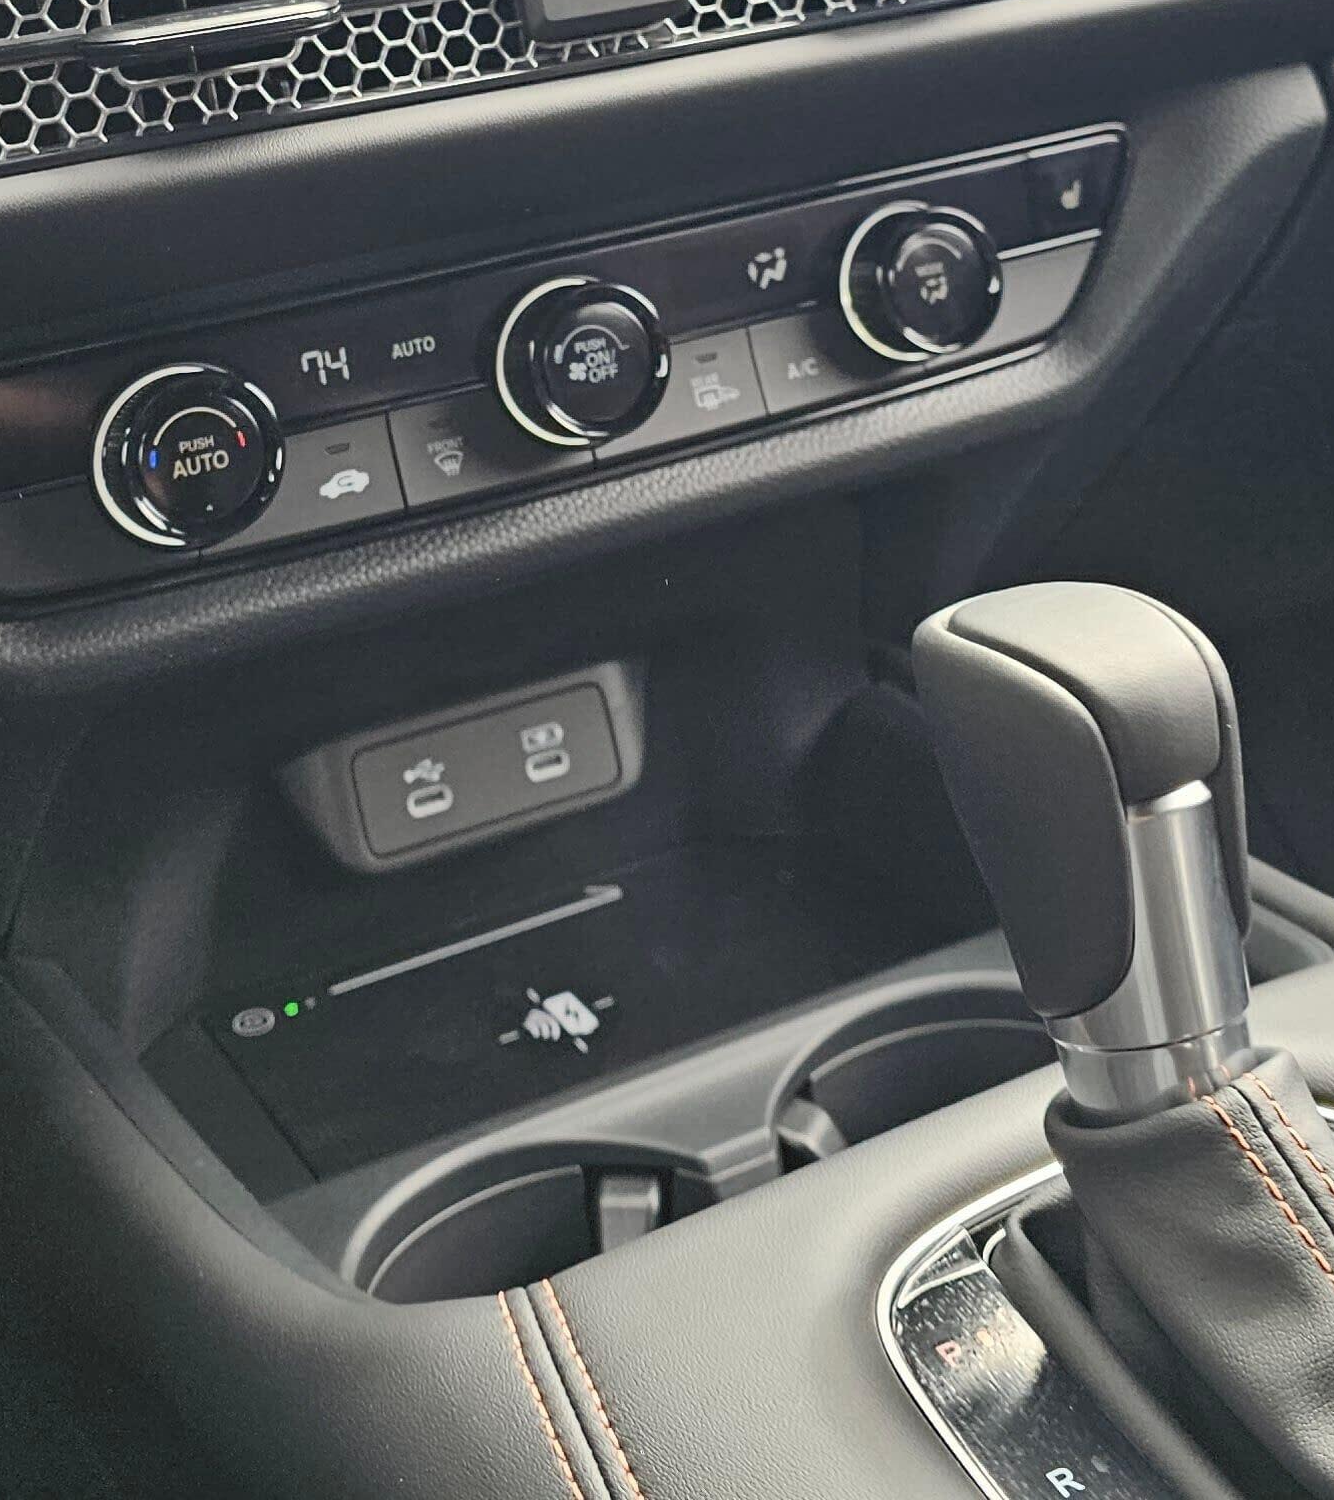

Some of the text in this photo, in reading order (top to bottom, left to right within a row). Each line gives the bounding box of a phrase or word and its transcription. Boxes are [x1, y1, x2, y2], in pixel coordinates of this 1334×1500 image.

[391, 335, 436, 360] AUTO
[574, 337, 607, 353] PUSH
[301, 347, 350, 385] 74
[588, 362, 619, 383] OFF
[787, 356, 819, 380] A/C
[178, 434, 215, 454] PUSH
[172, 449, 230, 480] AUTO
[935, 1339, 963, 1369] P
[1045, 1467, 1086, 1499] R
